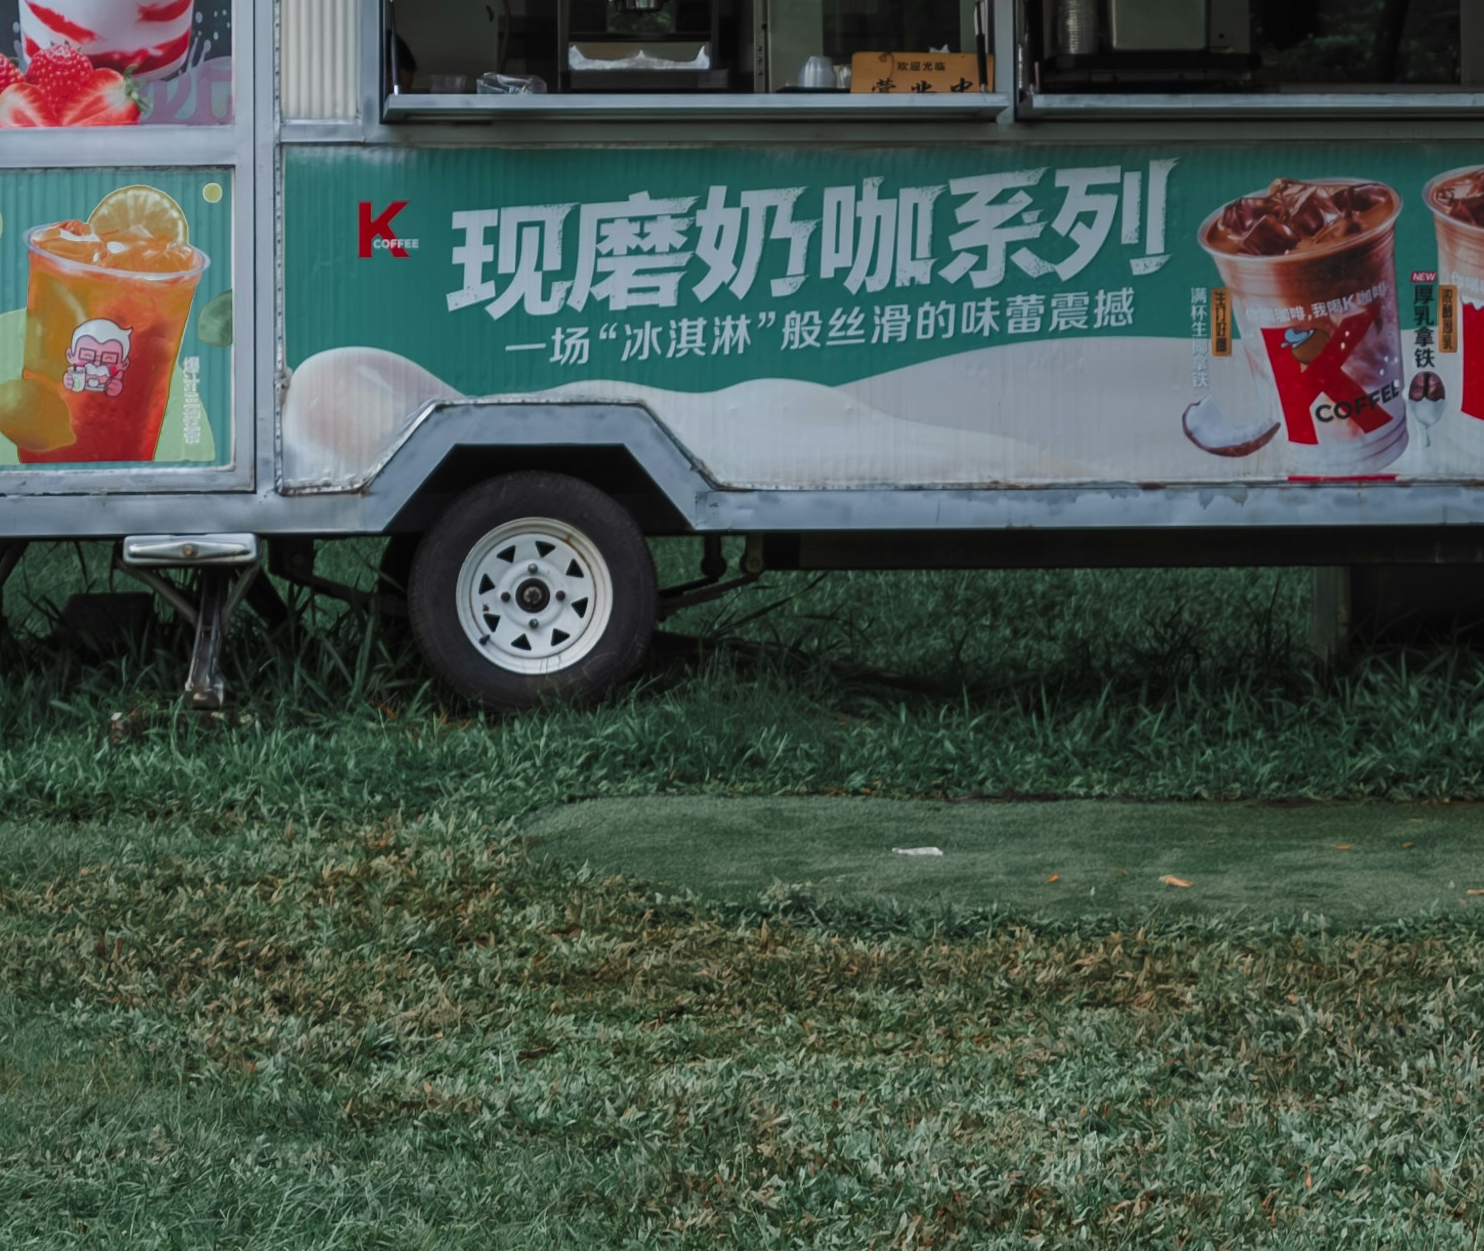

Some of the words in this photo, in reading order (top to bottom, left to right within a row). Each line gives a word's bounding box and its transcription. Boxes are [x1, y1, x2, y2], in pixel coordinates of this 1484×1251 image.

[897, 60, 946, 72] 欢迎光临
[358, 200, 410, 258] K
[372, 238, 420, 249] COFFEE
[446, 157, 1179, 321] 现磨奶咖系列
[1412, 272, 1437, 282] NEW
[504, 287, 1135, 366] 一场“冰淇淋”般丝滑的味蕾震撼
[1413, 285, 1436, 368] 厚乳拿铁
[1260, 301, 1394, 445] K
[1314, 379, 1400, 423] COFFEE
